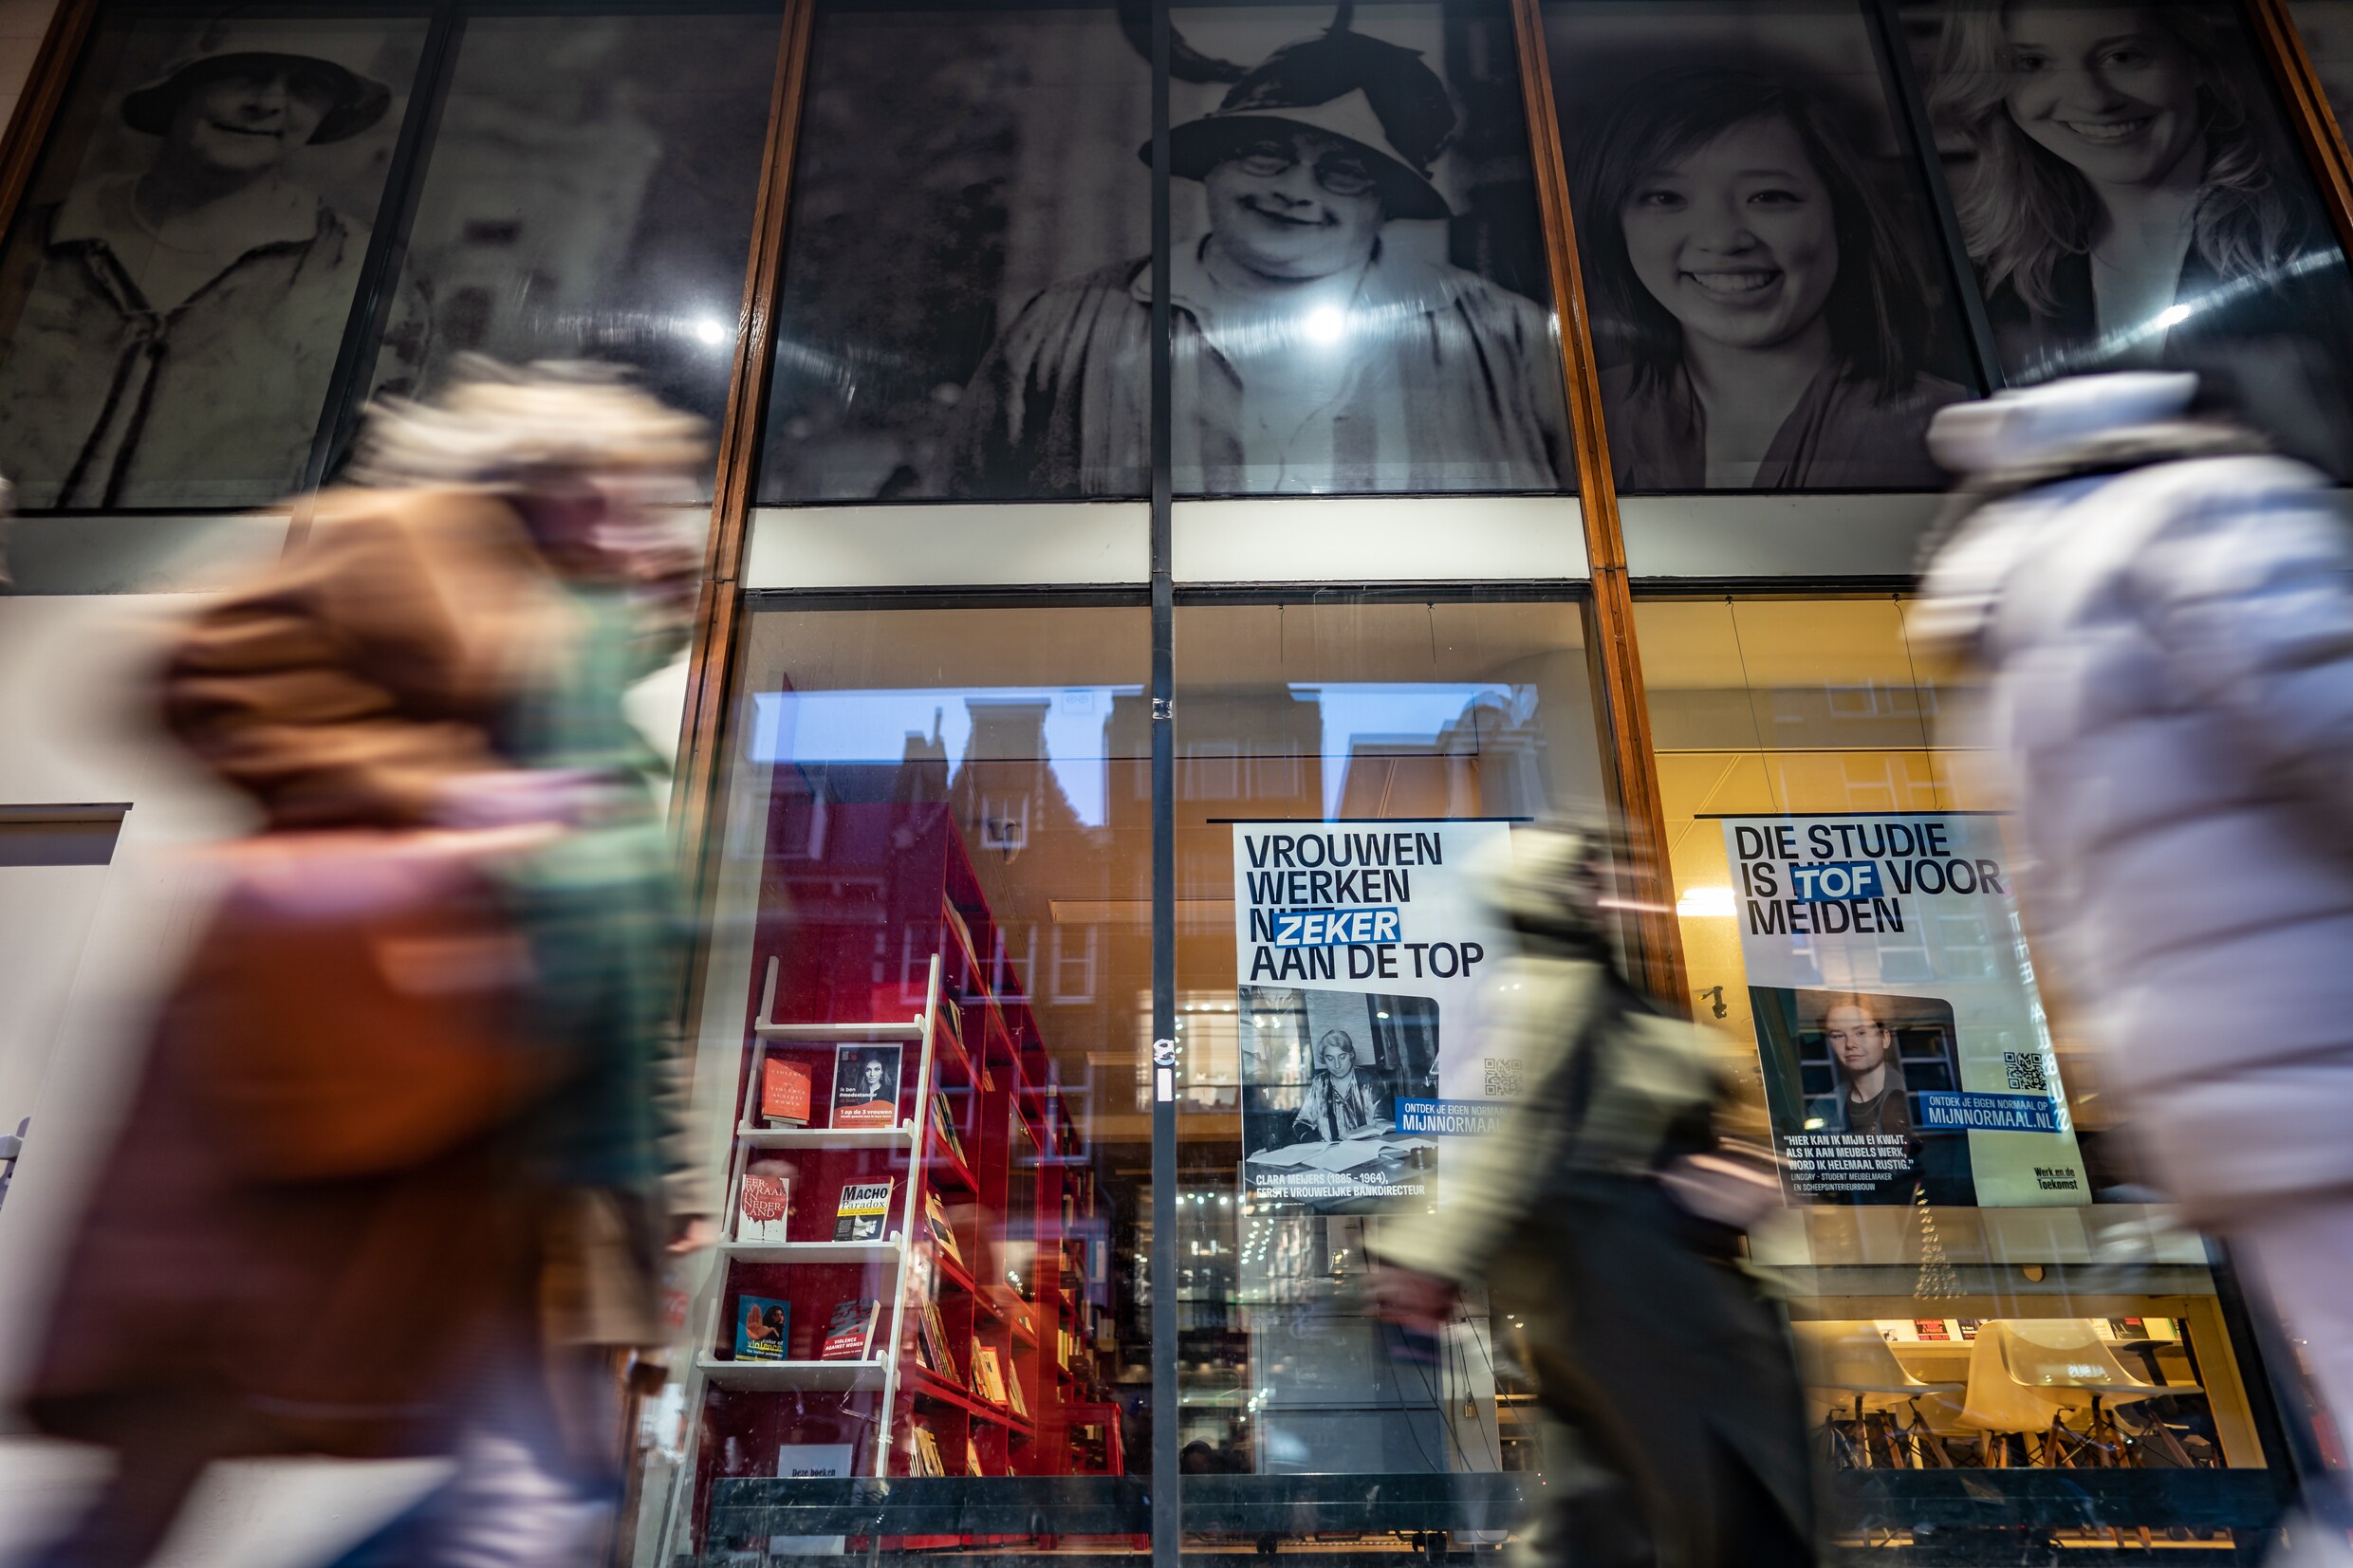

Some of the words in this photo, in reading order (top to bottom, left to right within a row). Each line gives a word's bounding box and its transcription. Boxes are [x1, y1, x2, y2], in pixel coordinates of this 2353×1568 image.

[1734, 825, 1799, 860] DIE
[1807, 823, 1951, 858] STUDIE
[1245, 832, 1443, 868] VROUWEN
[1741, 862, 1778, 898] IS
[1794, 865, 1872, 899] TOF
[1885, 858, 2005, 895] VOOR
[1246, 869, 1411, 905] WERKEN
[1748, 897, 1905, 935] MEIDEN
[1276, 911, 1399, 947] ZEKER
[1250, 945, 1337, 981] AAN
[1348, 944, 1399, 979] DE
[1404, 942, 1484, 978] TOP
[770, 1086, 806, 1095] VIOLENCE
[1404, 1103, 1435, 1114] ONTDEK
[1436, 1104, 1445, 1115] JE
[1448, 1105, 1469, 1116] EIGEN
[1929, 1097, 1960, 1107] ONTDEK
[1962, 1098, 1972, 1107] JE
[1973, 1098, 1994, 1108] EIGEN
[1997, 1099, 2036, 1110] NORMAAL
[2038, 1101, 2047, 1111] OP
[1928, 1107, 2055, 1129] MIJNNORMAAL.NL
[1810, 1135, 1829, 1146] KAN
[1831, 1135, 1840, 1145] IK
[1841, 1135, 1865, 1145] MIJN
[1866, 1135, 1875, 1145] EI
[1877, 1134, 1907, 1145] KWIJT.
[1787, 1148, 1803, 1157] ALS
[1805, 1148, 1814, 1157] IK
[1816, 1148, 1834, 1157] AAN
[1836, 1148, 1877, 1157] MEUBELS
[1878, 1147, 1907, 1158] WERK,
[1788, 1160, 1815, 1170] WORD
[1817, 1160, 1826, 1170] IK
[1827, 1160, 1874, 1170] HELEMAAL
[1849, 1172, 1892, 1181] MEUBELMAKER
[2034, 1167, 2053, 1176] Werk
[2066, 1168, 2075, 1176] de
[746, 1178, 769, 1188] EER-
[1256, 1173, 1285, 1186] CLARA
[1288, 1173, 1325, 1185] MEIJERS
[1327, 1172, 1351, 1186] (1885
[2036, 1178, 2078, 1190] Toekomst
[746, 1185, 786, 1196] WRAAK
[843, 1186, 888, 1200] MACHO
[1256, 1187, 1288, 1198] EERSTE
[1290, 1186, 1351, 1198] VROUWELIJKE
[1354, 1185, 1426, 1196] BANKDIRECTEUR
[1803, 1183, 1876, 1191] SCHEEPSINTERIEURBOUW
[745, 1192, 758, 1201] IN
[744, 1199, 785, 1211] NEDER-
[842, 1200, 885, 1208] Paradox
[744, 1208, 775, 1217] LAND
[748, 1339, 783, 1351] violence
[791, 1468, 808, 1477] Deze
[810, 1467, 836, 1477] boeken
